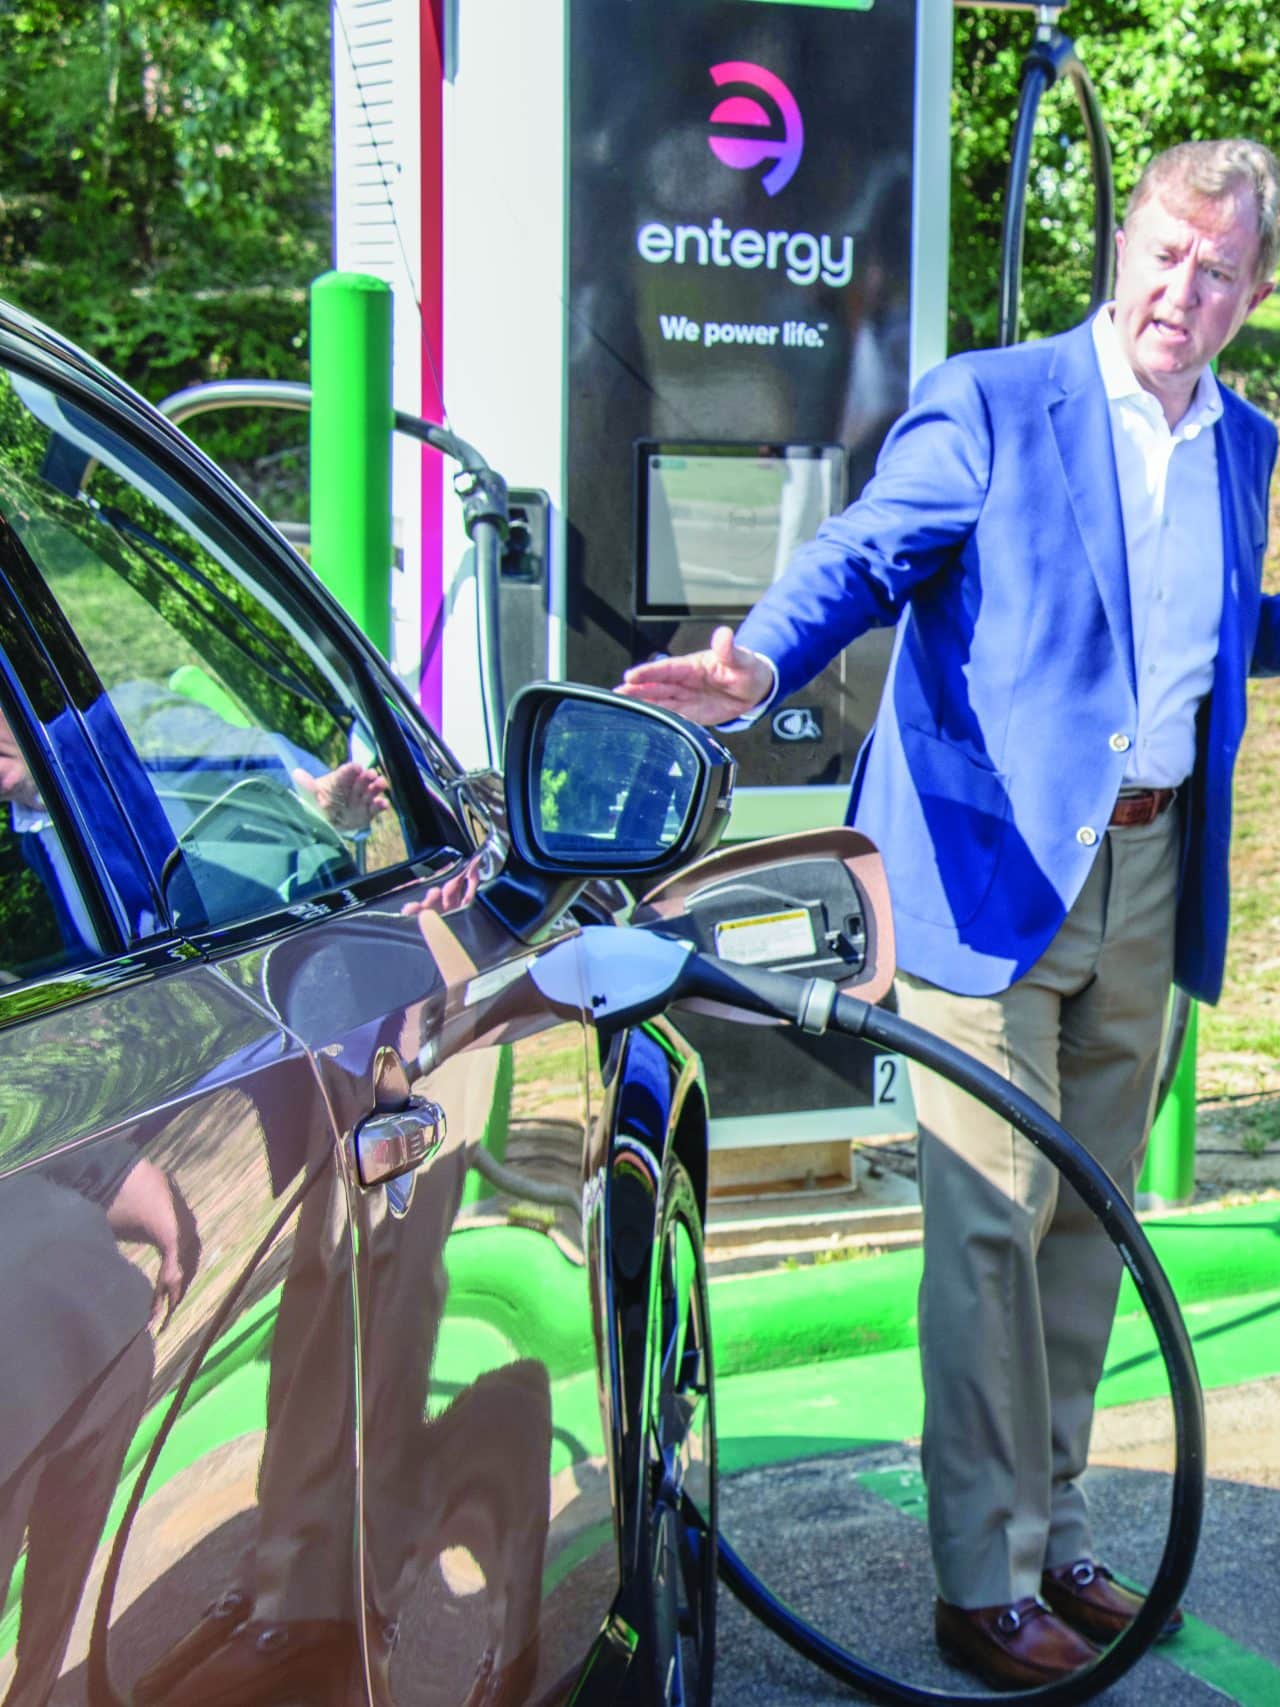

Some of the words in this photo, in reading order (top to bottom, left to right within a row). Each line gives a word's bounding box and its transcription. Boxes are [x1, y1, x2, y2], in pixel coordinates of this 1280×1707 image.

[637, 217, 854, 288] entergy
[659, 314, 700, 342] We
[704, 322, 780, 348] power
[879, 1060, 897, 1103] 2
